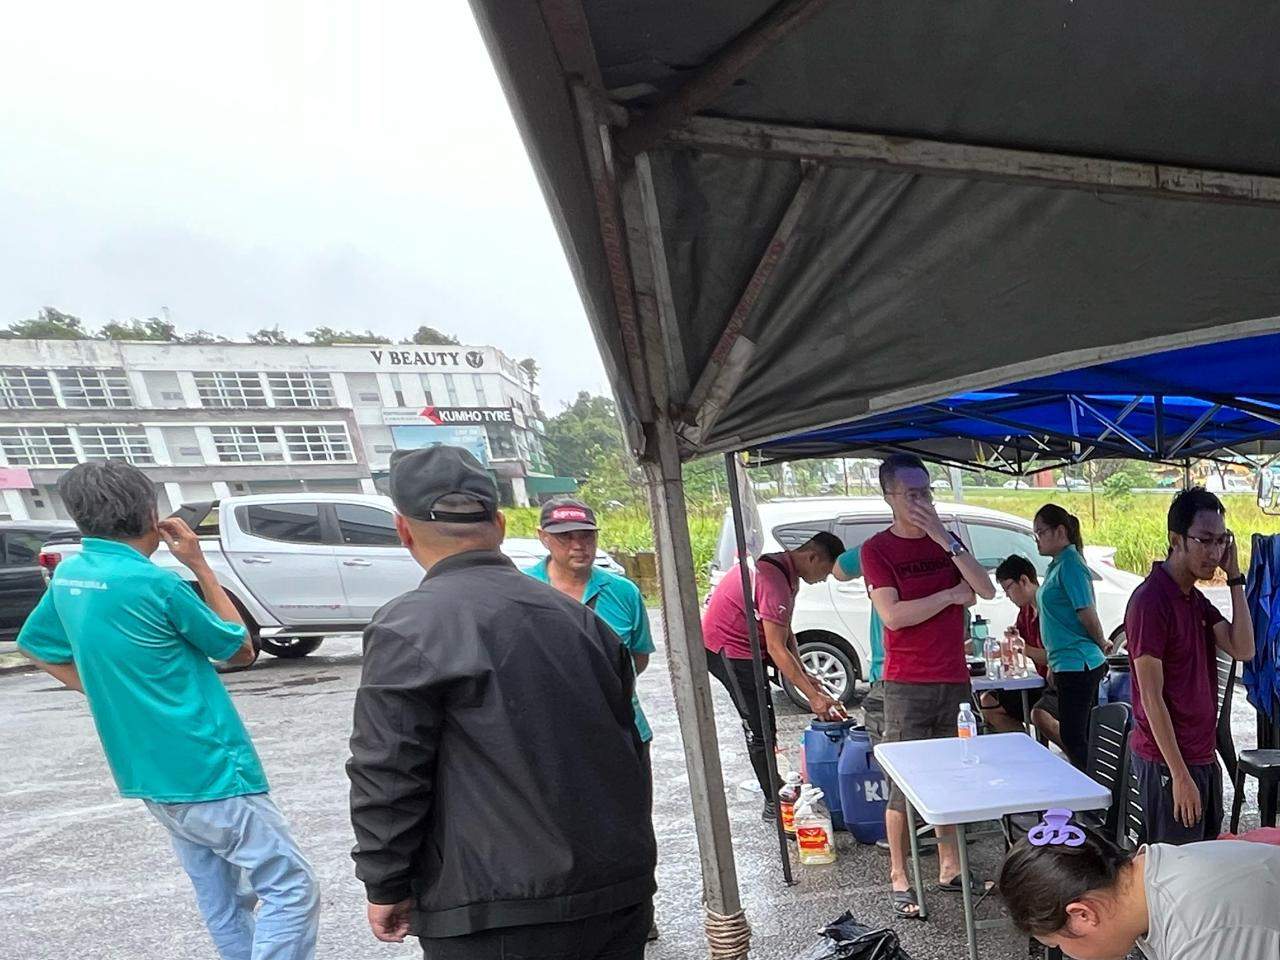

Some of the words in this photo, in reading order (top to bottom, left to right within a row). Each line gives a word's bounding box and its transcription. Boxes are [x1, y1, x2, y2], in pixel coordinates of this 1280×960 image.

[371, 351, 383, 365] V
[389, 351, 460, 366] BEAUTY
[439, 410, 482, 422] KUMHO
[485, 410, 512, 422] TYRE
